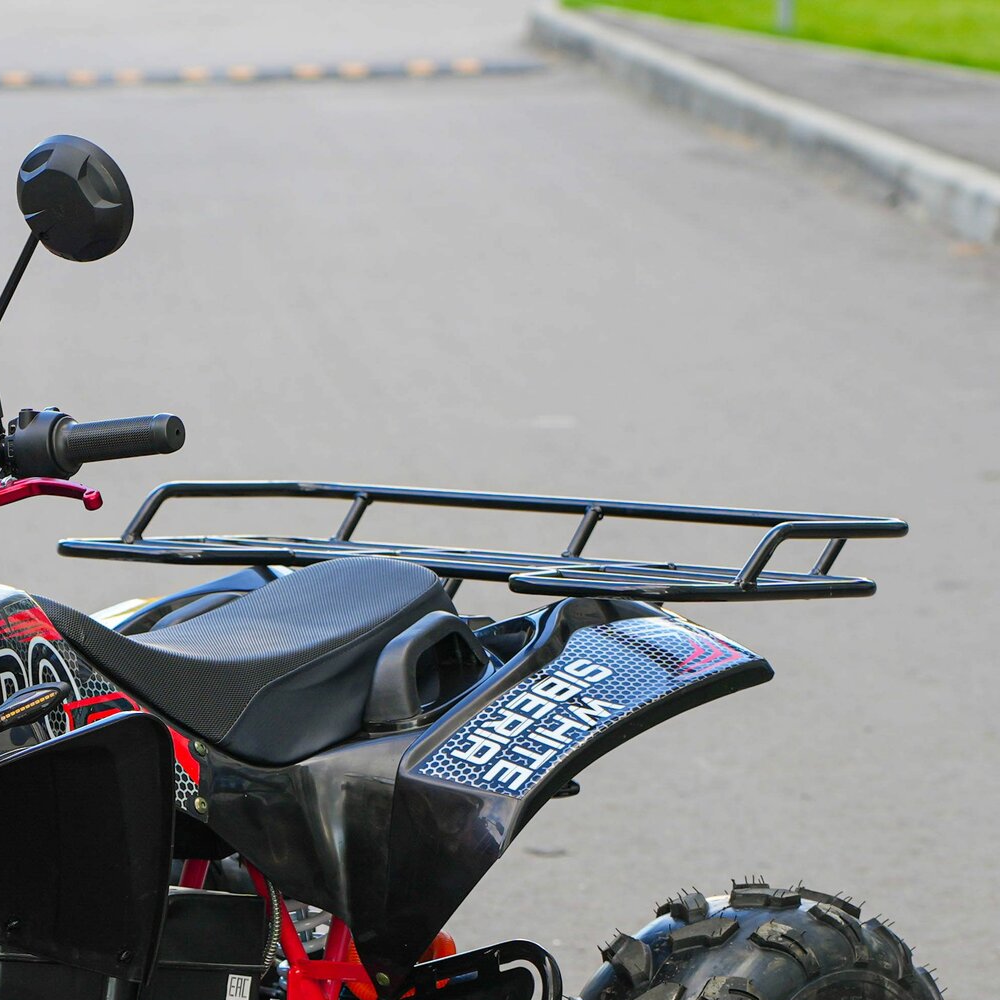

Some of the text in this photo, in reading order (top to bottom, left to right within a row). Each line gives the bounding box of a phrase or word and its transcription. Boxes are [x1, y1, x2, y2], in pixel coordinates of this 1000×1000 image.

[451, 658, 613, 765] SIBERIA
[482, 696, 626, 791] WHITE
[228, 976, 250, 999] EAC
